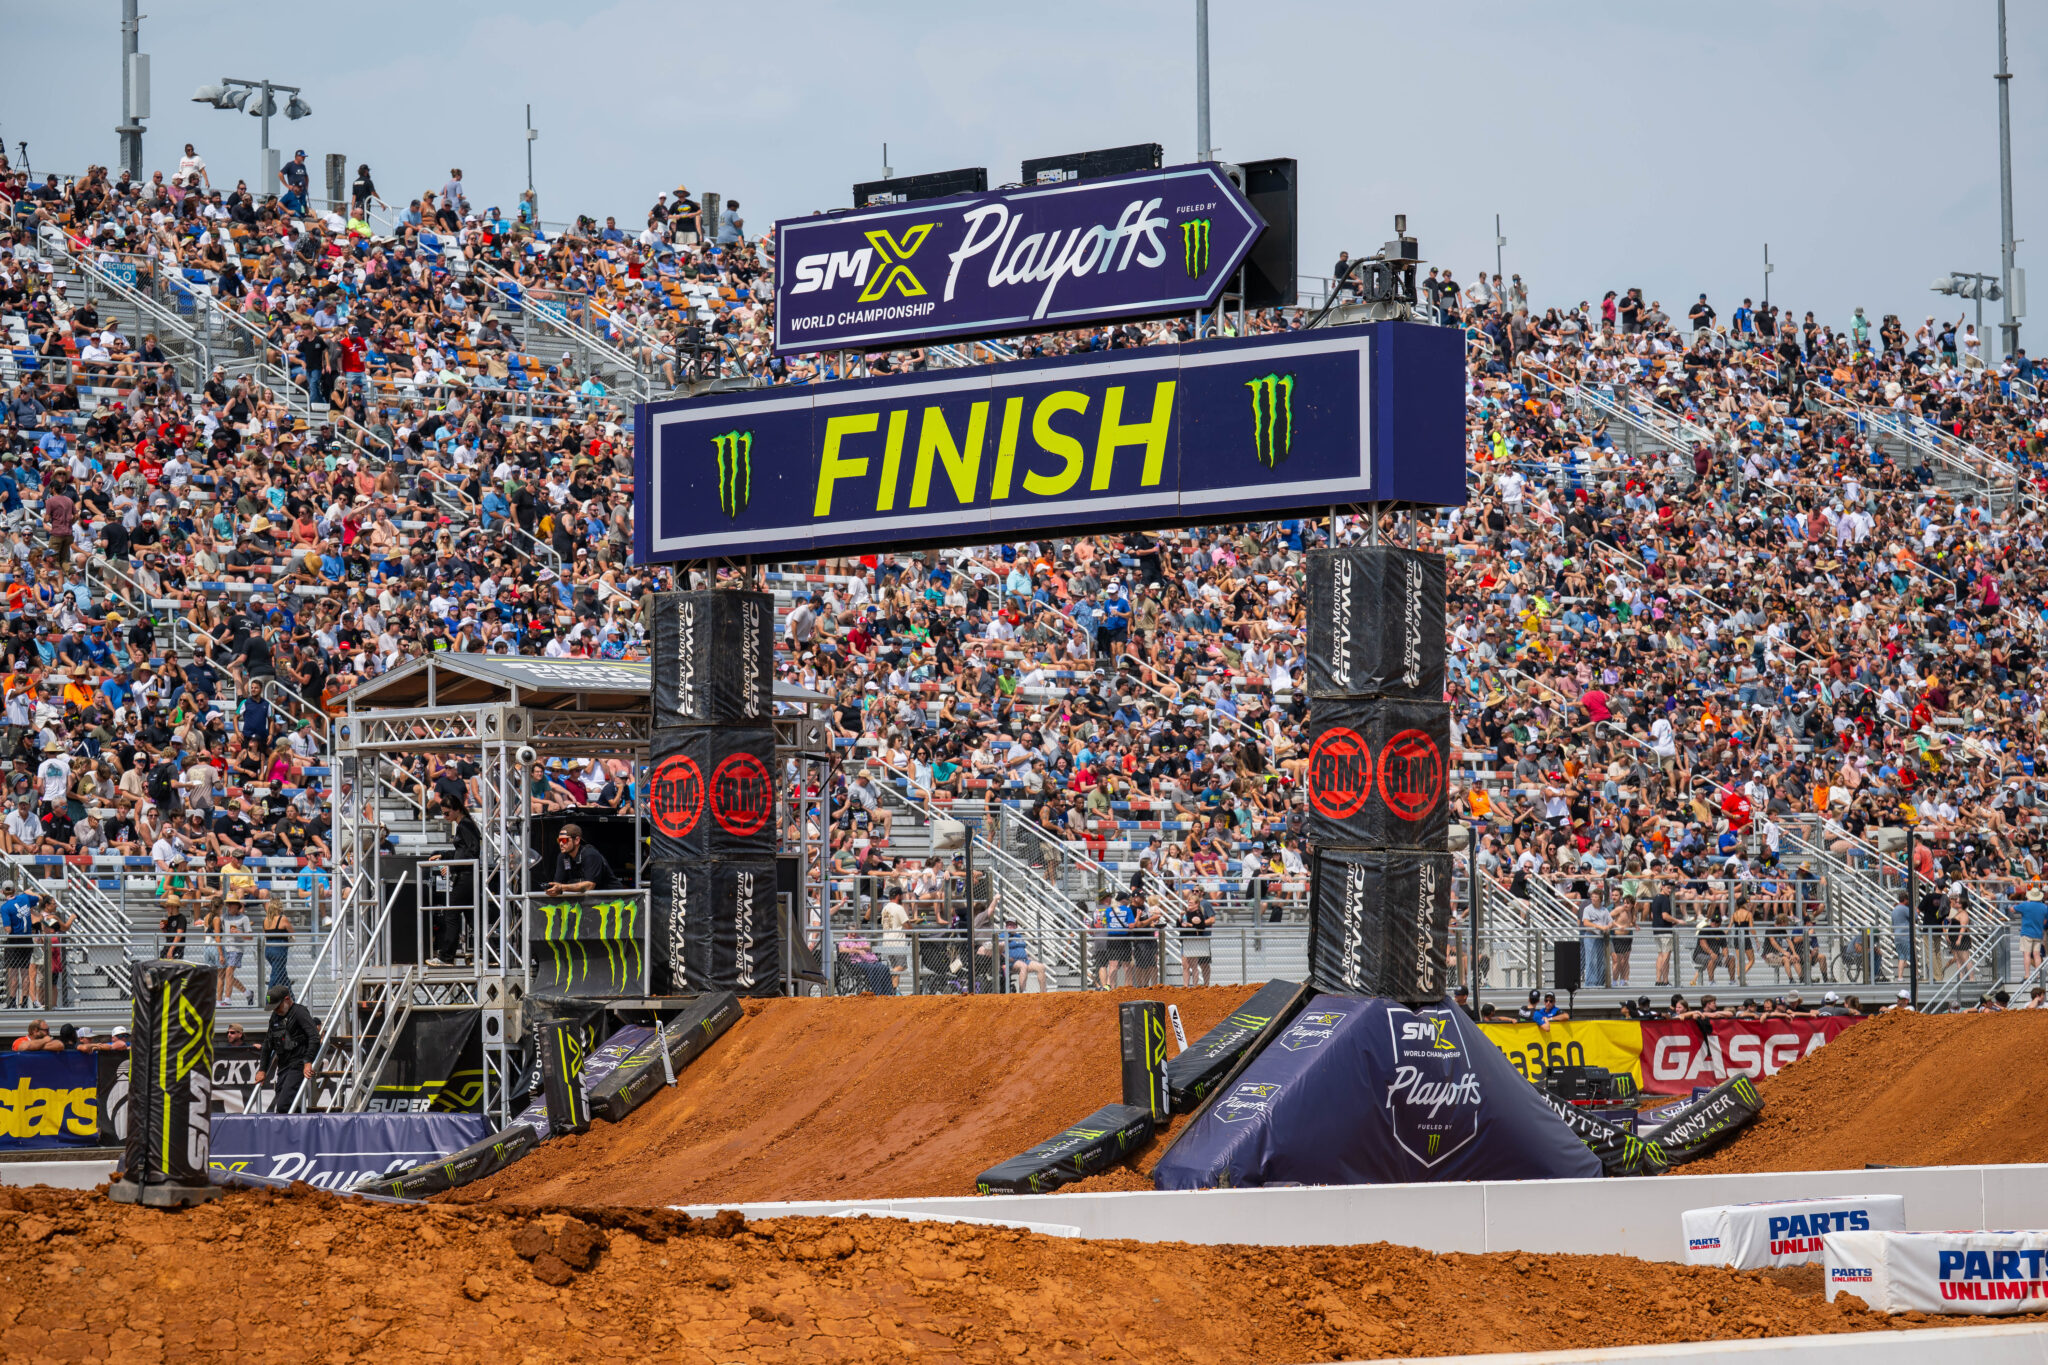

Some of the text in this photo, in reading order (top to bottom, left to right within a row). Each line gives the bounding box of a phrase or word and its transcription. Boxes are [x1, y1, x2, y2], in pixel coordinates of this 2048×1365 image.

[1176, 202, 1217, 213] FUELED BY
[790, 223, 934, 302] SMX
[944, 198, 1169, 319] Playoffs
[791, 302, 936, 331] WORLD CHAMPIONSHIP
[813, 381, 1177, 516] FINISH
[678, 602, 687, 700] ROCKY MOUNTAIN
[742, 600, 751, 700] ROCKY MOUNTAIN
[1332, 558, 1341, 668] ROCKY MOUNTAIN
[1403, 559, 1414, 668] ROCKY MOUNTAIN
[669, 872, 679, 970] ROCKY MOUNTAIN
[735, 871, 744, 970] ROCKY MOUNTAIN
[1342, 861, 1355, 969] ROCKY MOUNTAIN
[1416, 861, 1426, 973] ROCKY MOUNTAIN
[1386, 1066, 1481, 1119] Playoffs
[1403, 1050, 1425, 1058] WORLD
[1685, 1115, 1731, 1151] ENERGY
[1689, 1237, 1720, 1246] PARTS
[1768, 1210, 1870, 1240] PARTS
[1938, 1250, 2048, 1280] PART
[1831, 1268, 1872, 1277] PARTS
